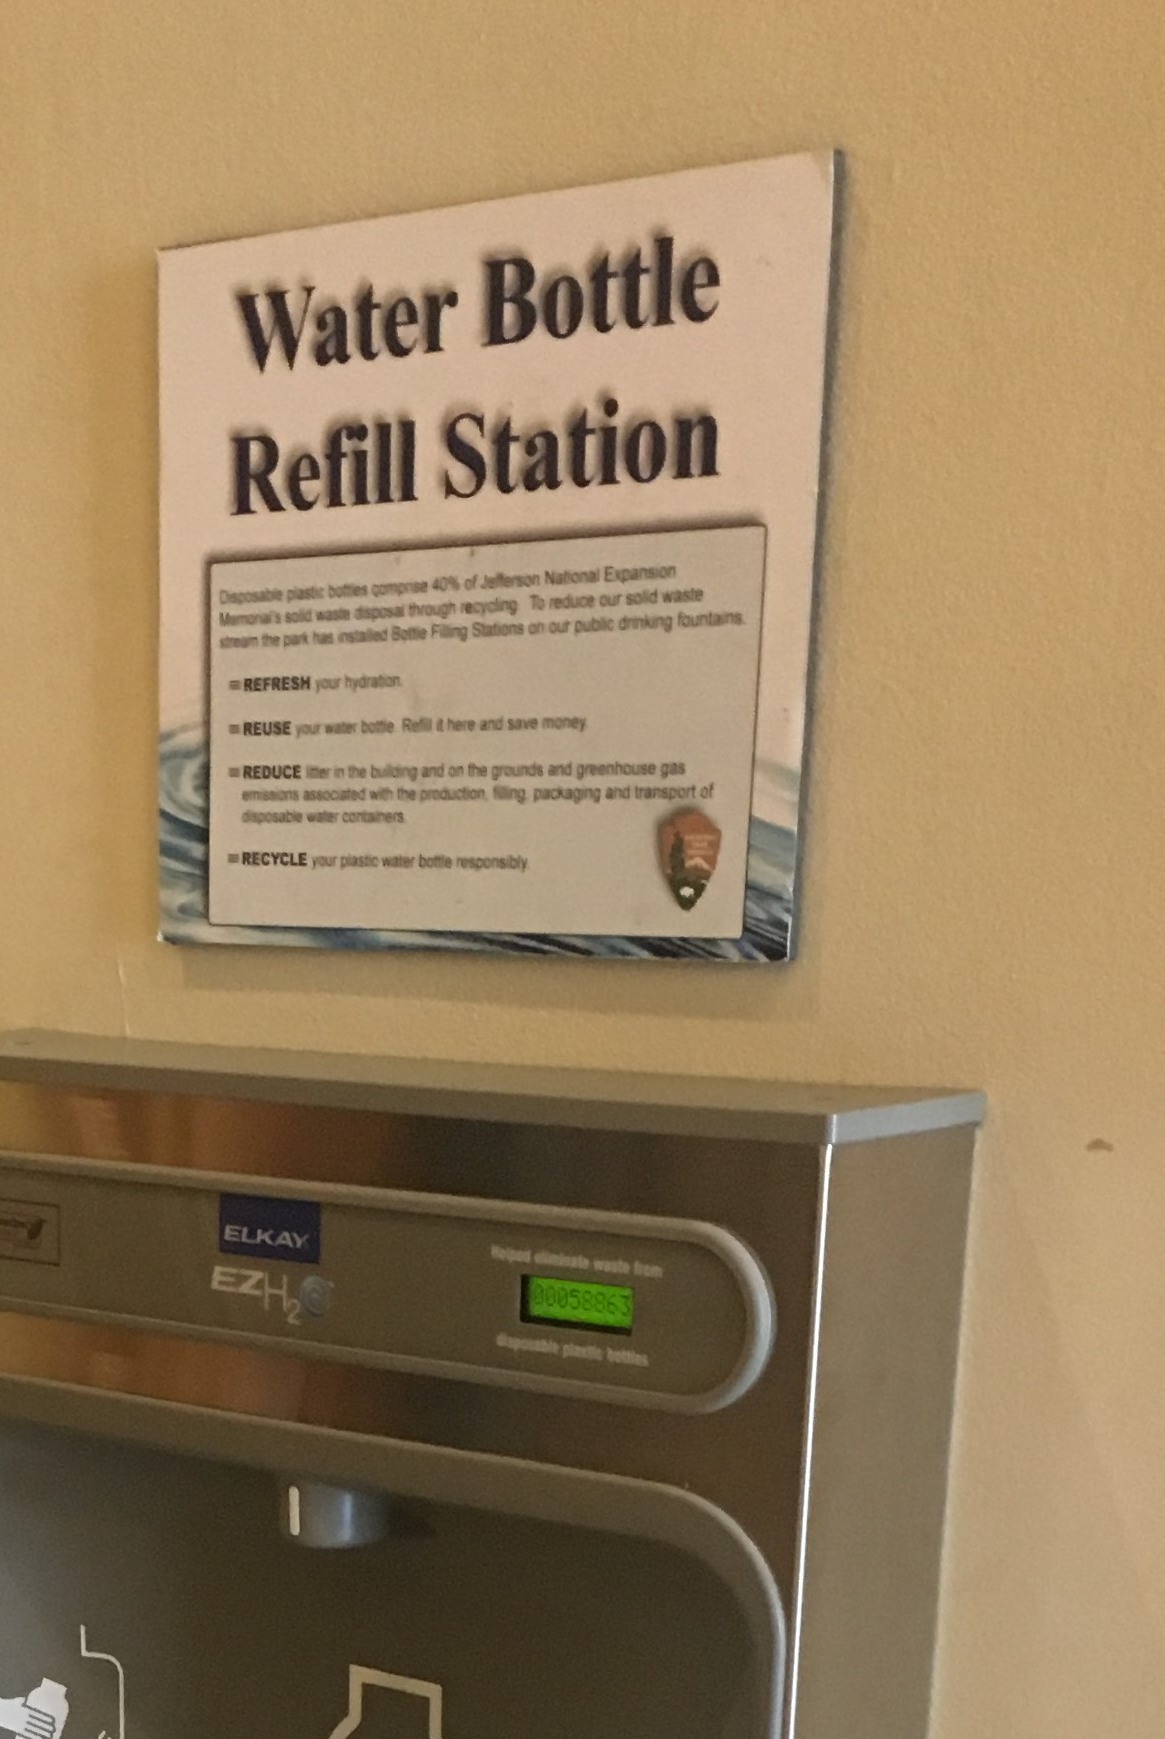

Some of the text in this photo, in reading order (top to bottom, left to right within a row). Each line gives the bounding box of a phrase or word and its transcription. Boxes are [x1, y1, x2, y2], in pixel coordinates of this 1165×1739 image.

[237, 236, 721, 374] Water Bottle
[230, 398, 720, 516] Refill Station
[220, 565, 676, 605] Disposable plastic bottles comprise 40% of Jefferson National Expansion
[220, 611, 281, 626] Memorial's
[286, 609, 312, 624] solid
[316, 608, 350, 622] waste
[354, 603, 404, 621] disposal
[409, 602, 456, 619] through
[530, 595, 545, 610] To
[549, 594, 595, 610] reduce
[599, 594, 622, 606] our
[626, 589, 657, 605] solid
[662, 587, 703, 603] waste
[220, 611, 746, 648] stream the park has installed Bottle Filling Stations on our public drinking fountains.
[244, 676, 311, 692] REFRESH
[315, 677, 339, 693] your
[244, 720, 292, 736] REUSE
[296, 722, 320, 738] your
[325, 721, 357, 735] water
[402, 717, 432, 733] Refill
[436, 717, 444, 732] it
[448, 717, 475, 732] here
[480, 716, 504, 731] and
[508, 718, 538, 731] save
[243, 760, 686, 781] REDUCE litter in the building and on the grounds and greenhouse gas
[242, 789, 299, 802] emissions
[303, 787, 365, 801] associated
[369, 786, 394, 801] with
[397, 786, 416, 801] the
[533, 785, 601, 804] packaging
[605, 785, 630, 800] and
[635, 785, 696, 801] transport
[700, 783, 714, 799] of
[242, 810, 302, 826] disposable
[307, 811, 338, 824] water
[243, 852, 307, 867] RECYCLE
[312, 855, 337, 870] your
[340, 853, 378, 870] plastic
[382, 854, 415, 868] water
[419, 852, 452, 869] bottle
[223, 1224, 310, 1249] ELKAY
